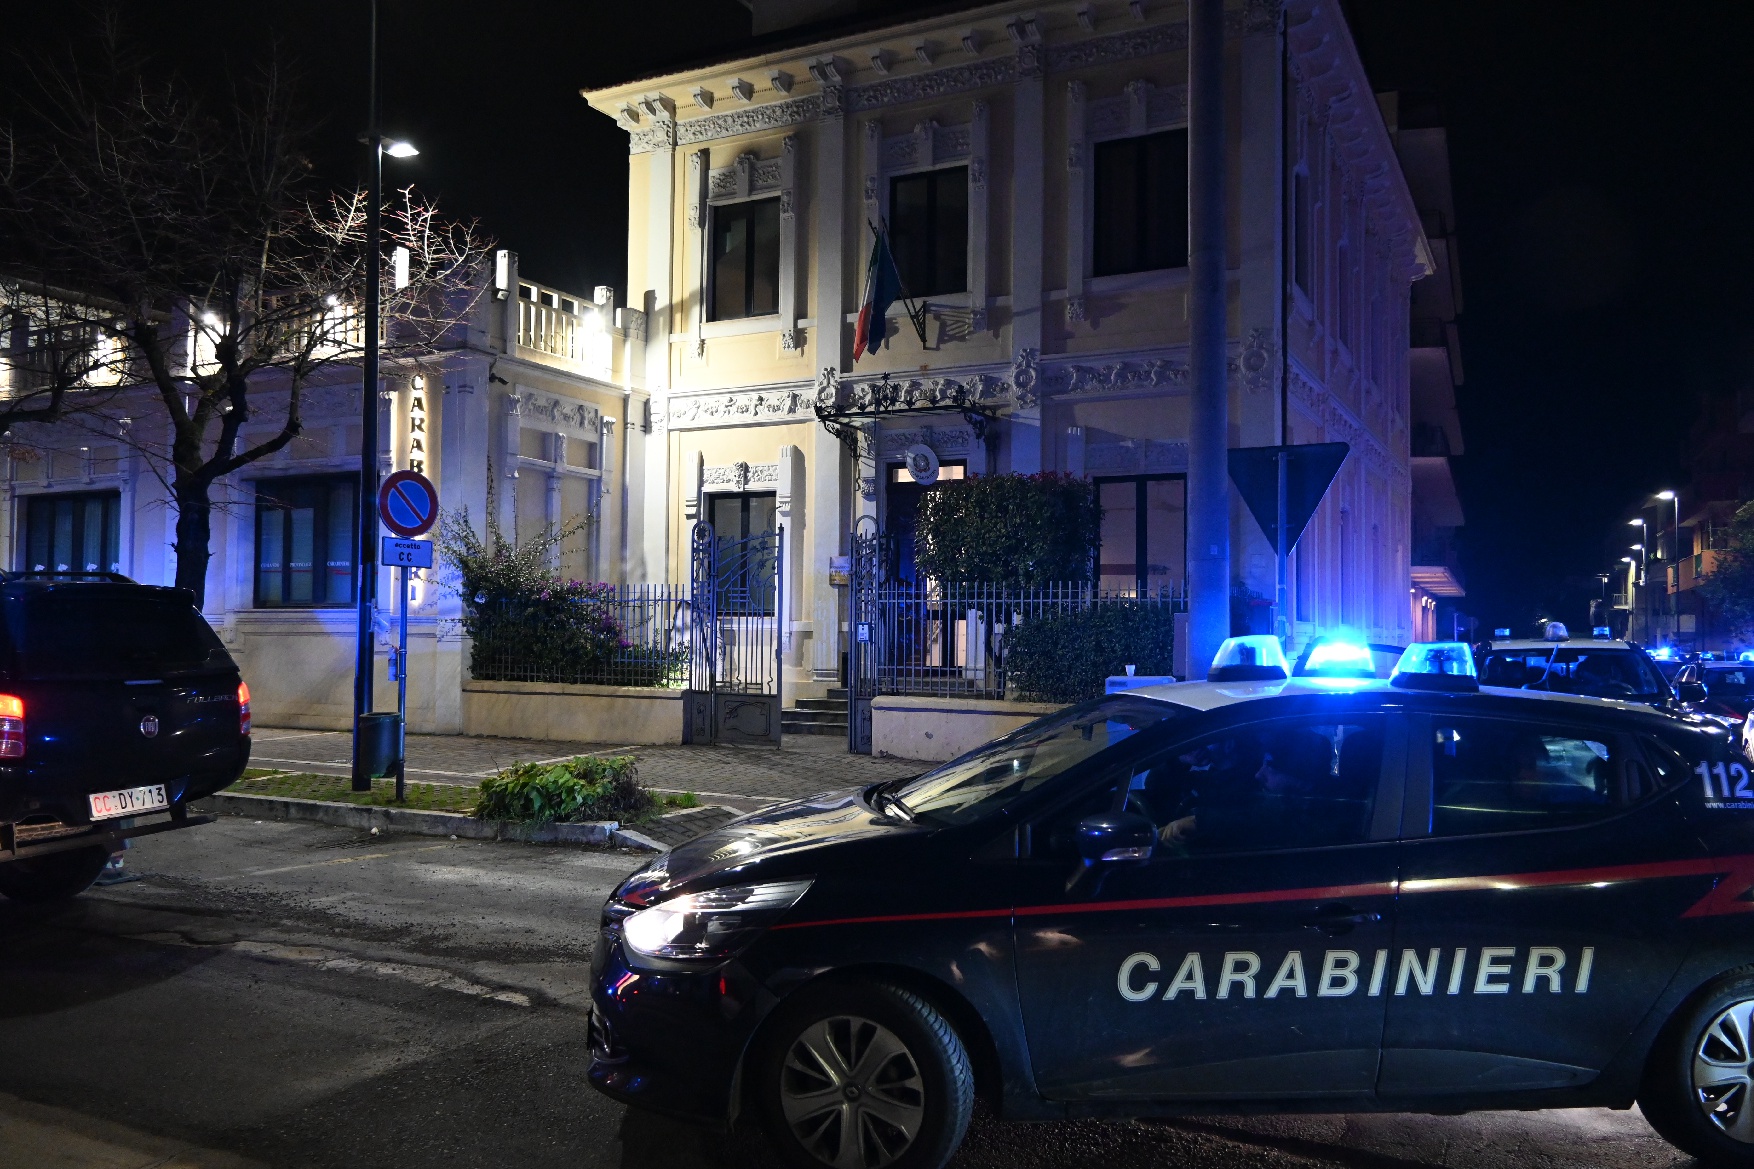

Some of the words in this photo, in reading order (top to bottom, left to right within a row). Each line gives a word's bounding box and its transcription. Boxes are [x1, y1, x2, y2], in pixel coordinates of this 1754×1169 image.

[1694, 761, 1754, 798] 112
[93, 795, 111, 813] CC
[140, 787, 164, 806] 713
[1117, 946, 1595, 1002] CARABINIERI
